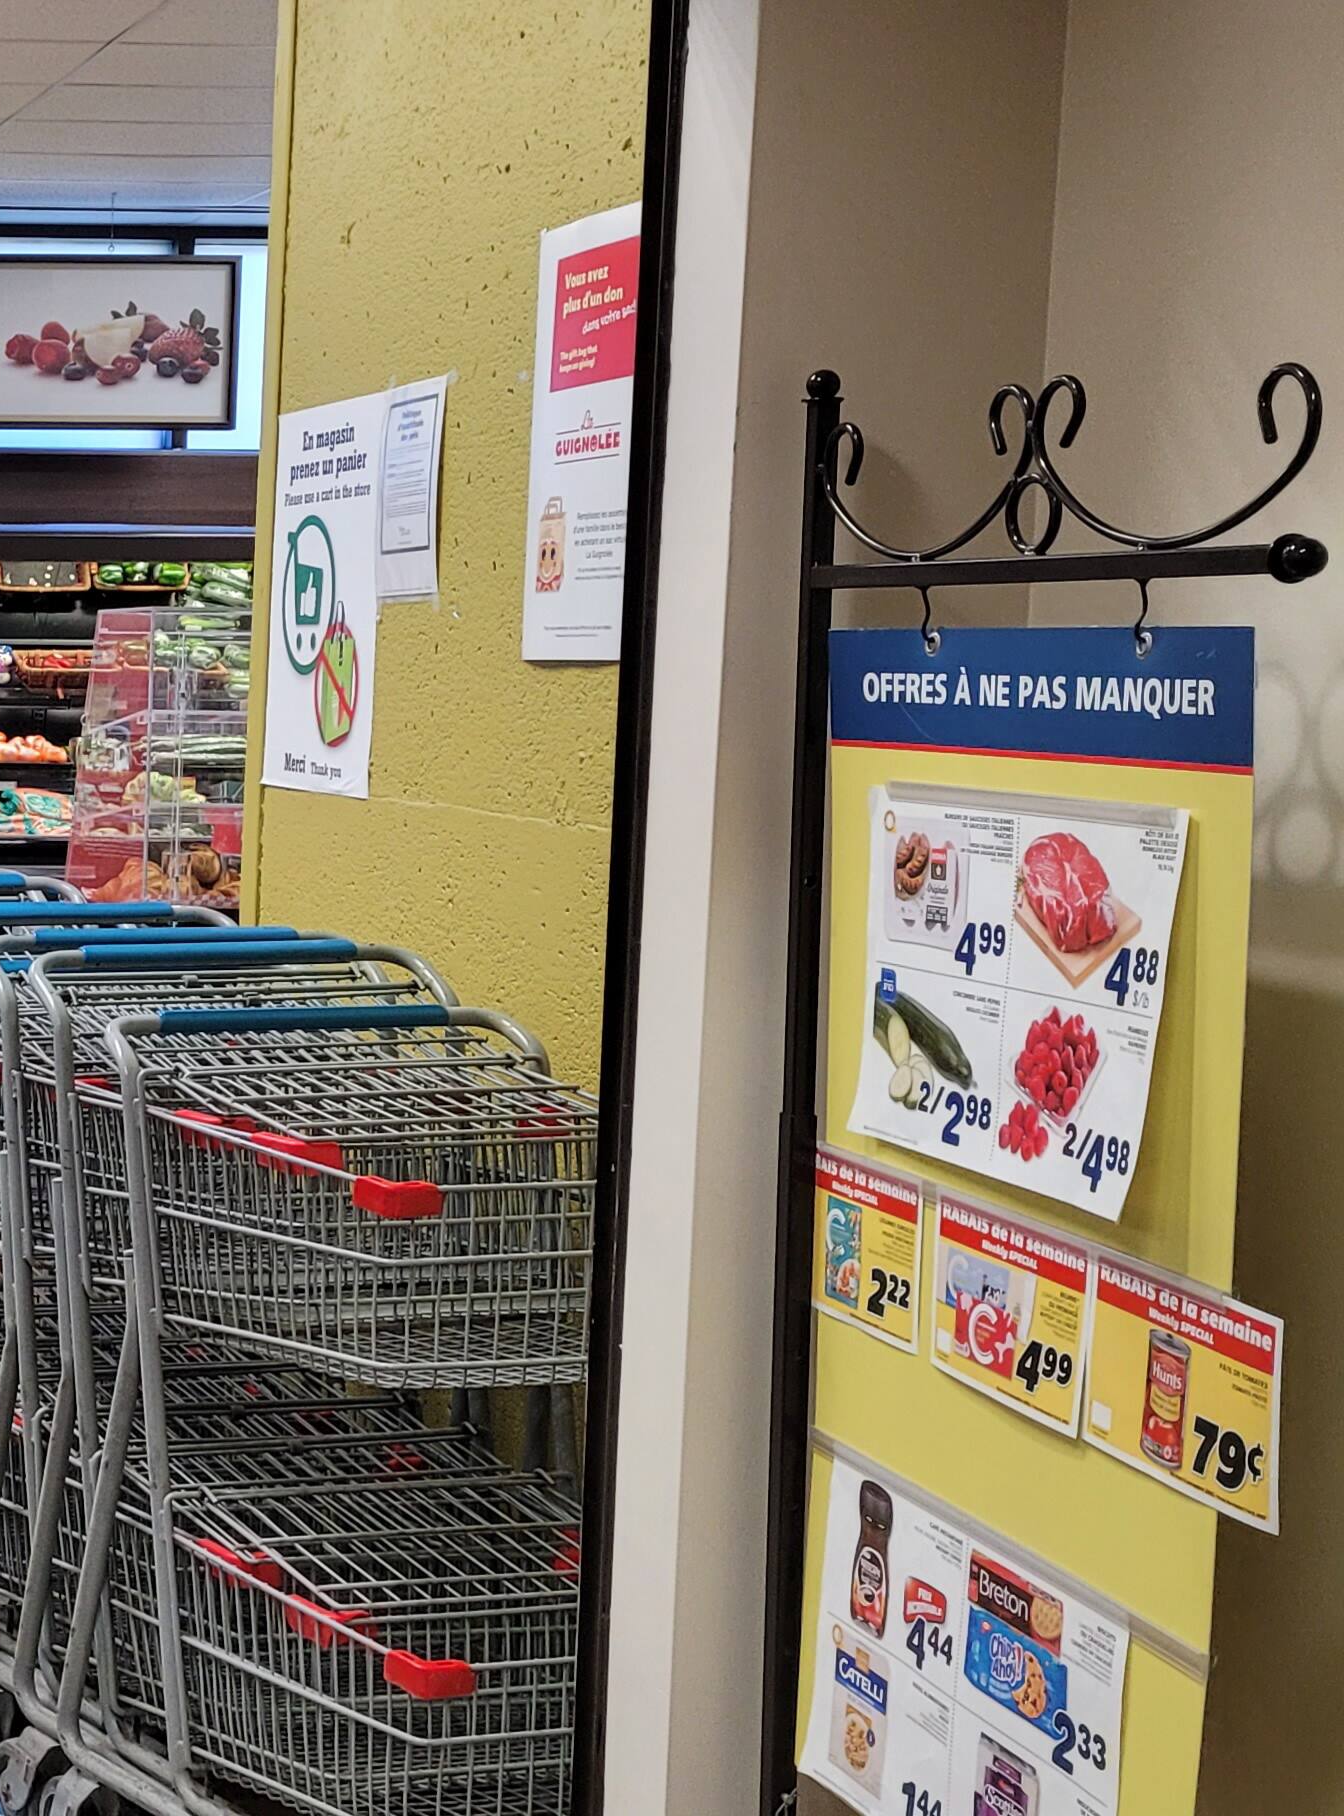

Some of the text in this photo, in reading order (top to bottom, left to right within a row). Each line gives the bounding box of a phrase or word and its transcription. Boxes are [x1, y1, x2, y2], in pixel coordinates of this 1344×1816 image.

[564, 266, 609, 290] Vous avez
[562, 285, 624, 320] plus d'un don
[302, 421, 355, 452] En magasin
[555, 428, 621, 458] GUIGNOLÉE
[290, 449, 367, 487] prenez un panier
[284, 493, 303, 507] Please
[342, 483, 353, 499] the
[353, 482, 371, 497] store
[862, 666, 1216, 720] OFFRES À NE PAS MANQUER
[283, 752, 342, 780] Merci Thank you
[839, 1164, 854, 1183] de
[855, 1169, 866, 1185] la
[867, 1174, 917, 1206] semaine
[942, 1202, 1086, 1273] RABAIS de la semaine
[1008, 1250, 1038, 1270] SPECIAL
[1100, 1265, 1273, 1352] RABAIS de la semaine
[1148, 1306, 1215, 1345] Weekly SPECIAL
[979, 1568, 1029, 1622] Breton
[990, 1634, 1017, 1660] Chips
[838, 1657, 884, 1704] CATELLI
